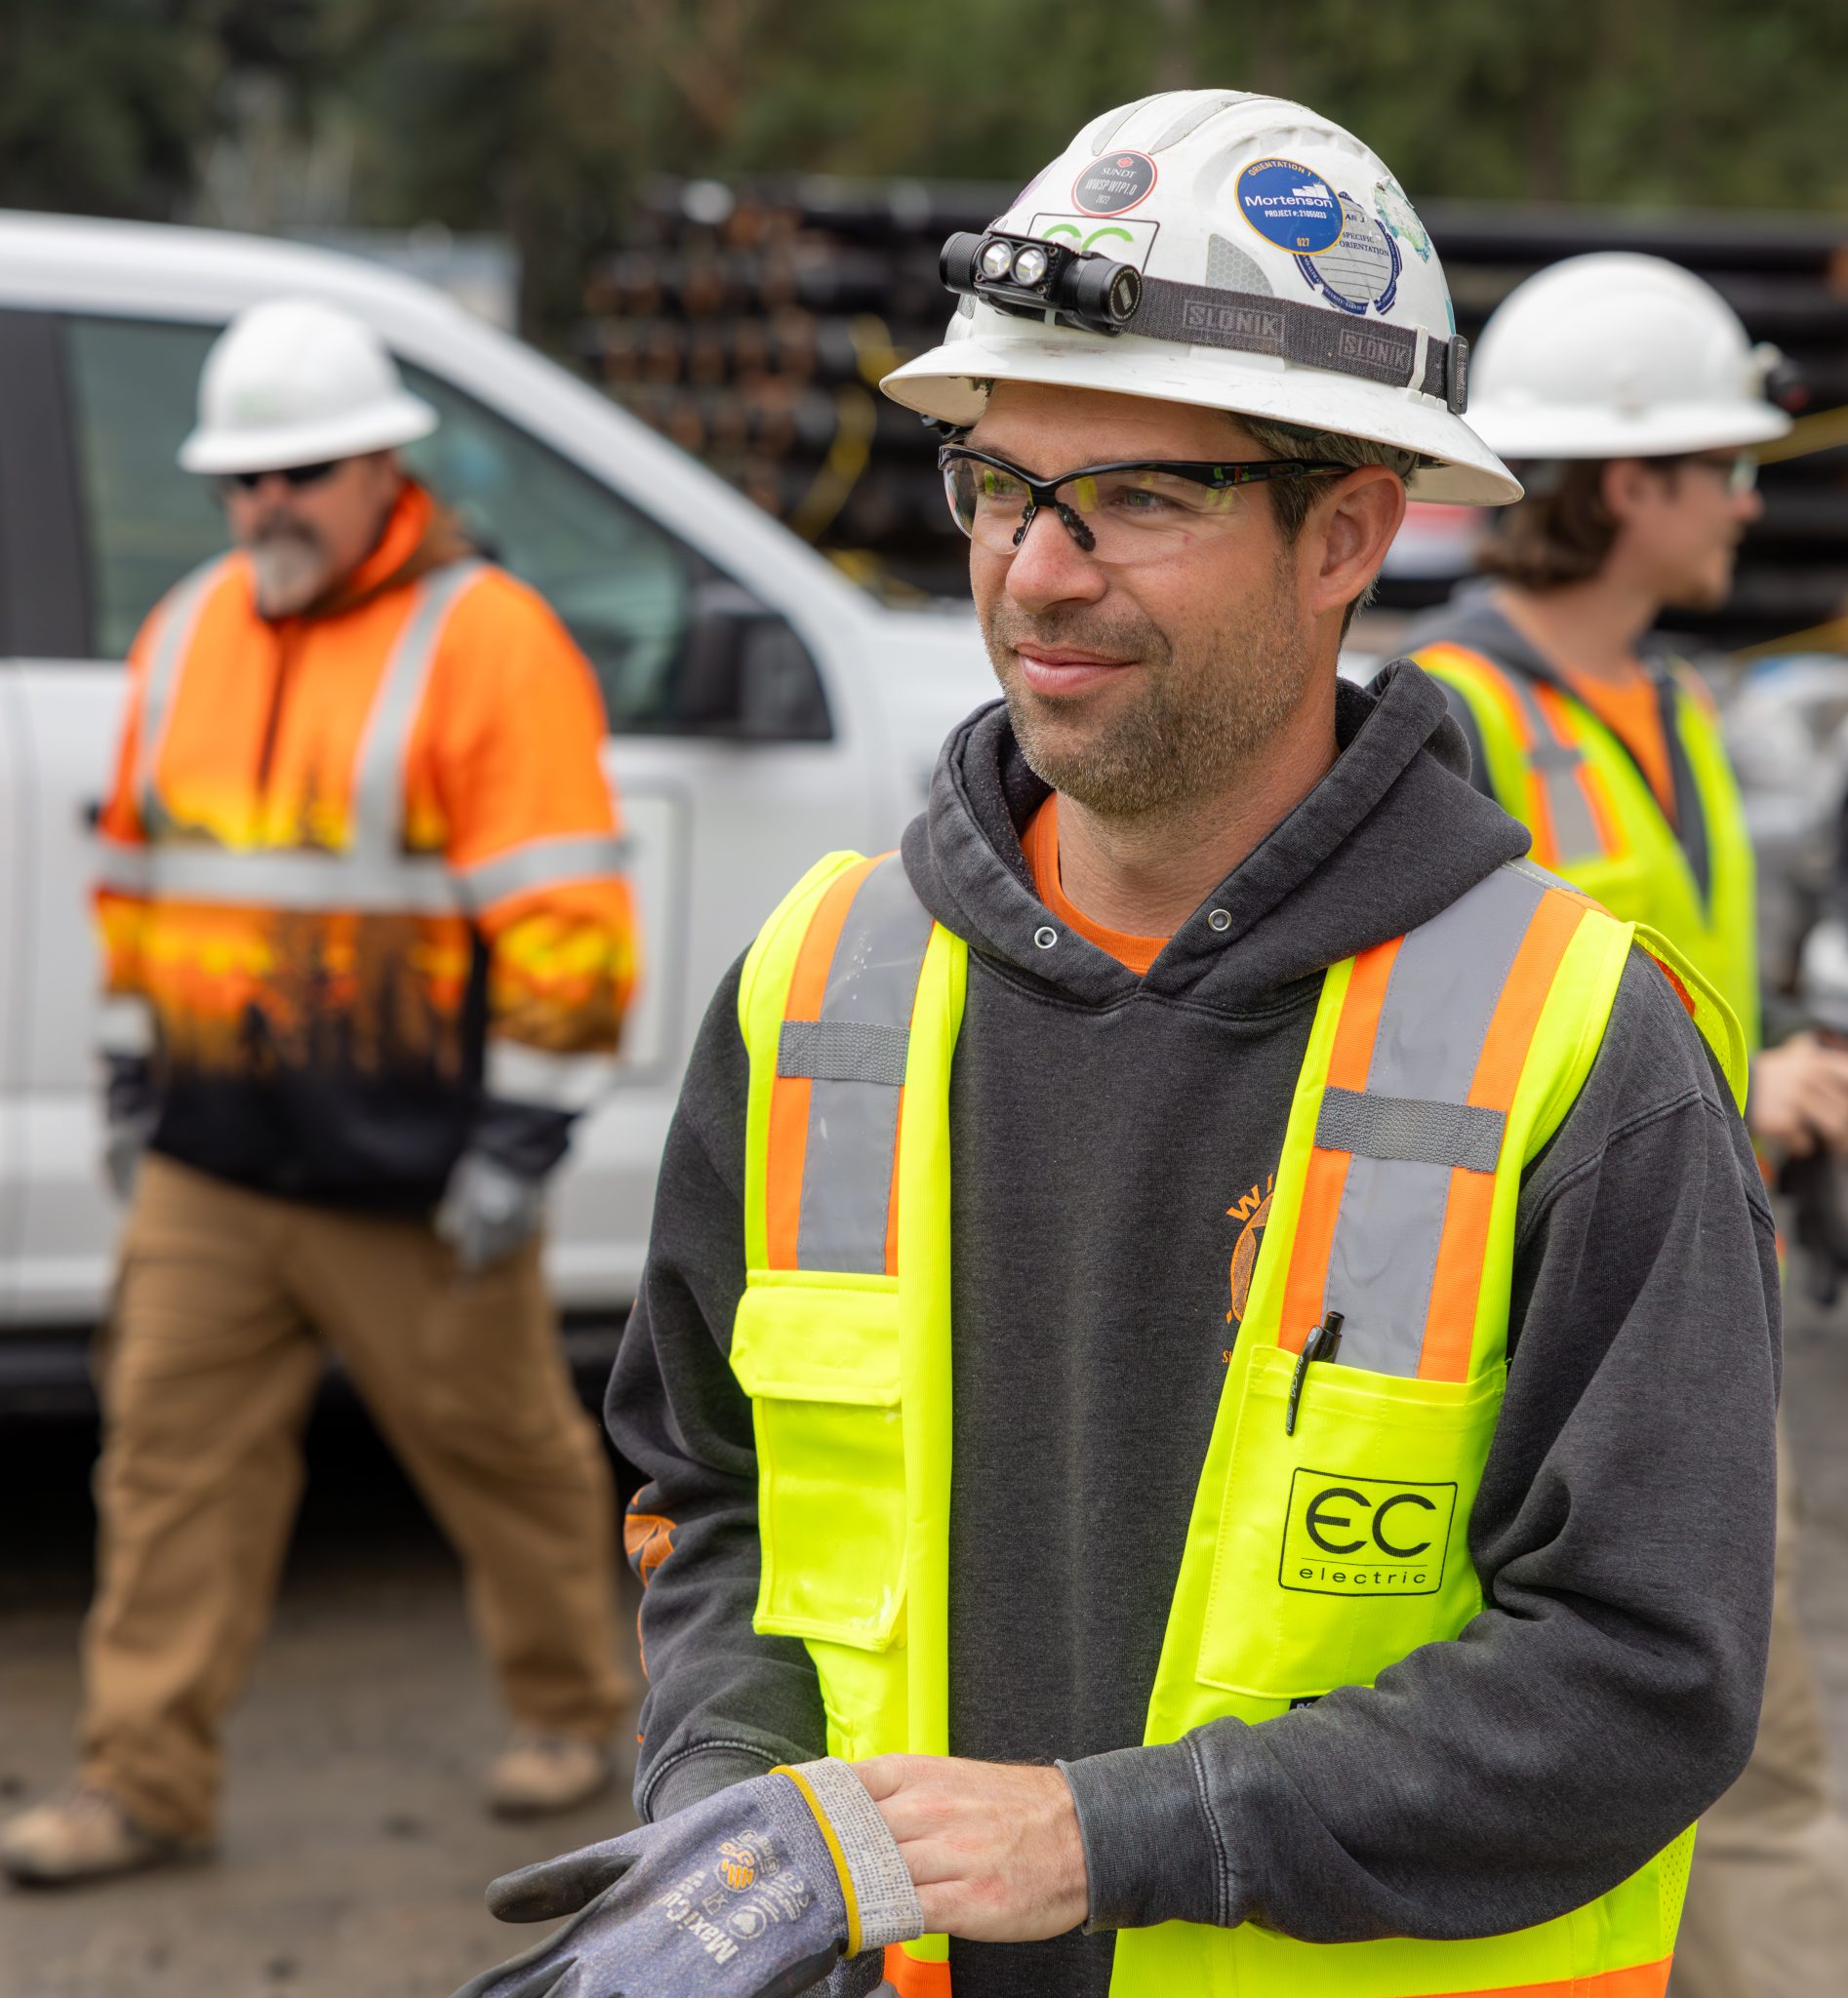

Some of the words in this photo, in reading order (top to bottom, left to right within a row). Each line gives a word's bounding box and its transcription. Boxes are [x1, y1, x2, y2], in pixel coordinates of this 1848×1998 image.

[1101, 167, 1137, 179] SUNDT
[1248, 160, 1305, 177] ORIENTATION
[1245, 195, 1333, 209] Mortenson
[1342, 231, 1375, 244] SPECIFIC
[1339, 241, 1390, 257] ORIENTATION
[1186, 306, 1278, 337] SLONIK
[1344, 335, 1407, 367] SLONIK
[1306, 1487, 1437, 1558] EC
[1299, 1567, 1426, 1584] electric
